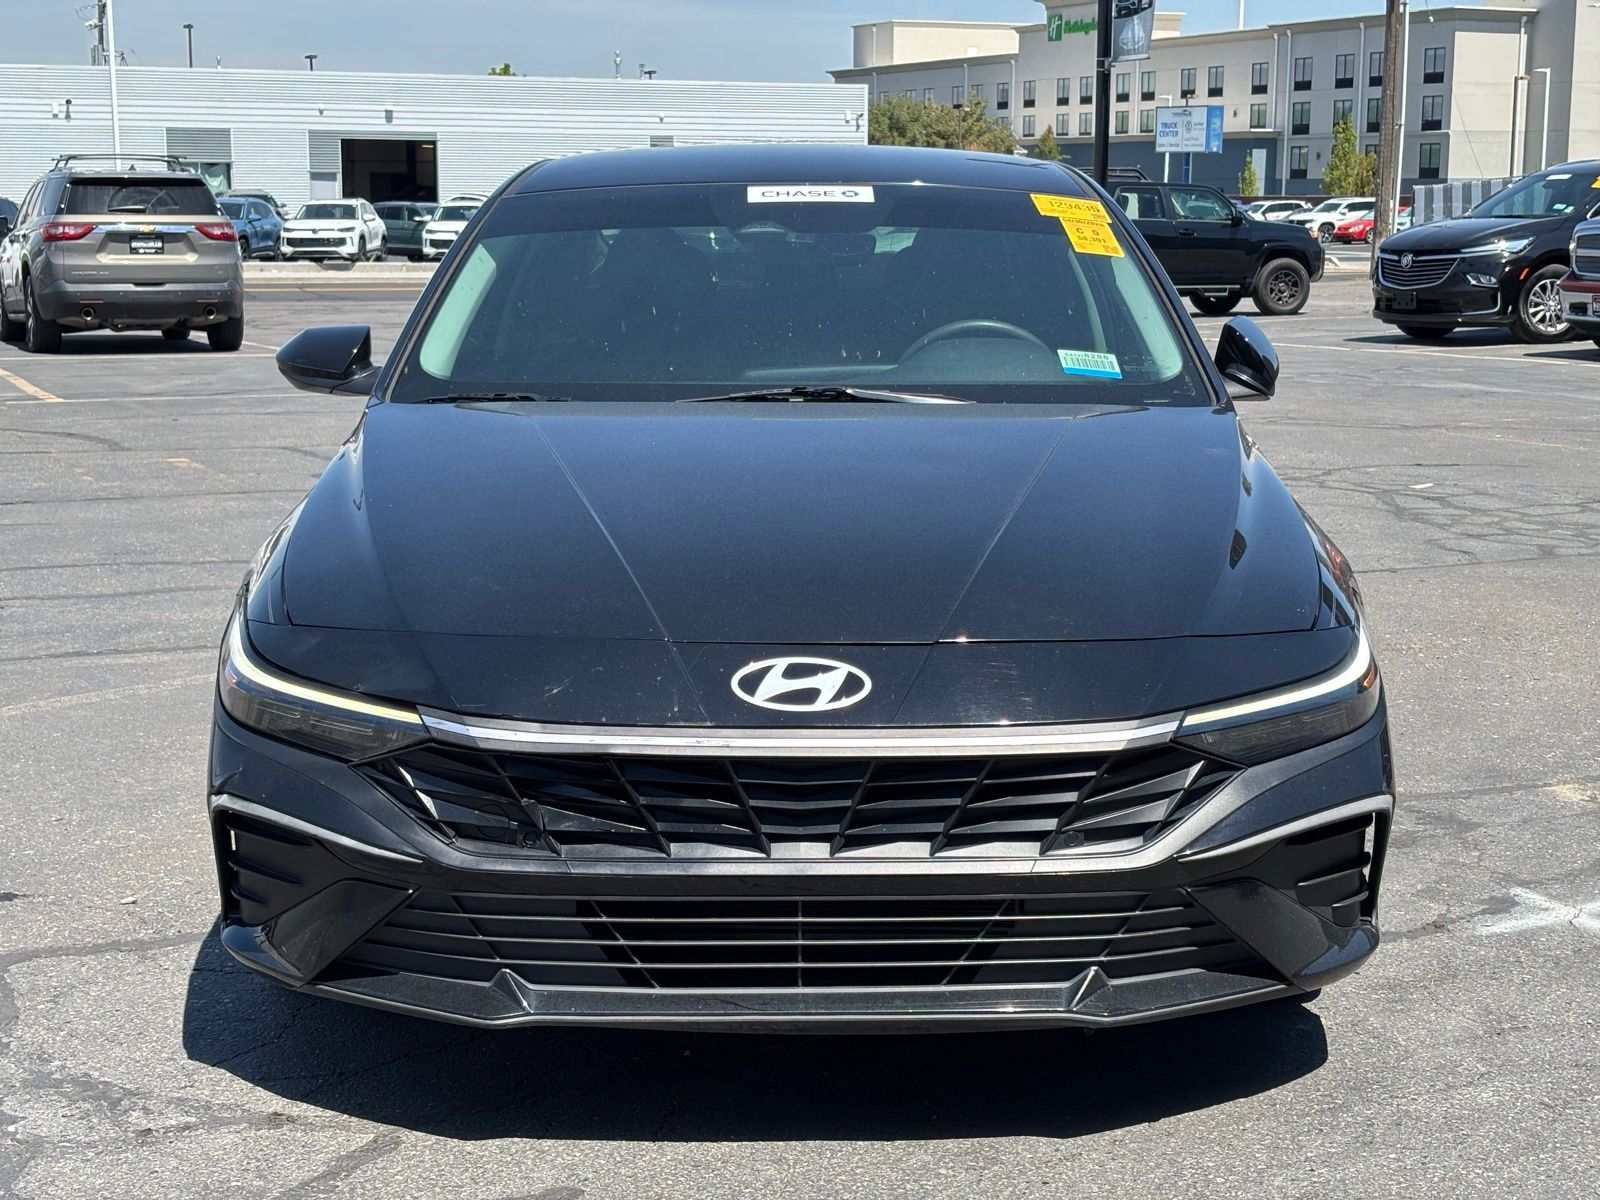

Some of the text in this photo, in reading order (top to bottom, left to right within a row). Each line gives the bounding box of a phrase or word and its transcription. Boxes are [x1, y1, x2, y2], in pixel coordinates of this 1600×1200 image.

[761, 190, 837, 198] CHASE
[1048, 200, 1101, 213] 129435
[1075, 227, 1100, 237] C 5
